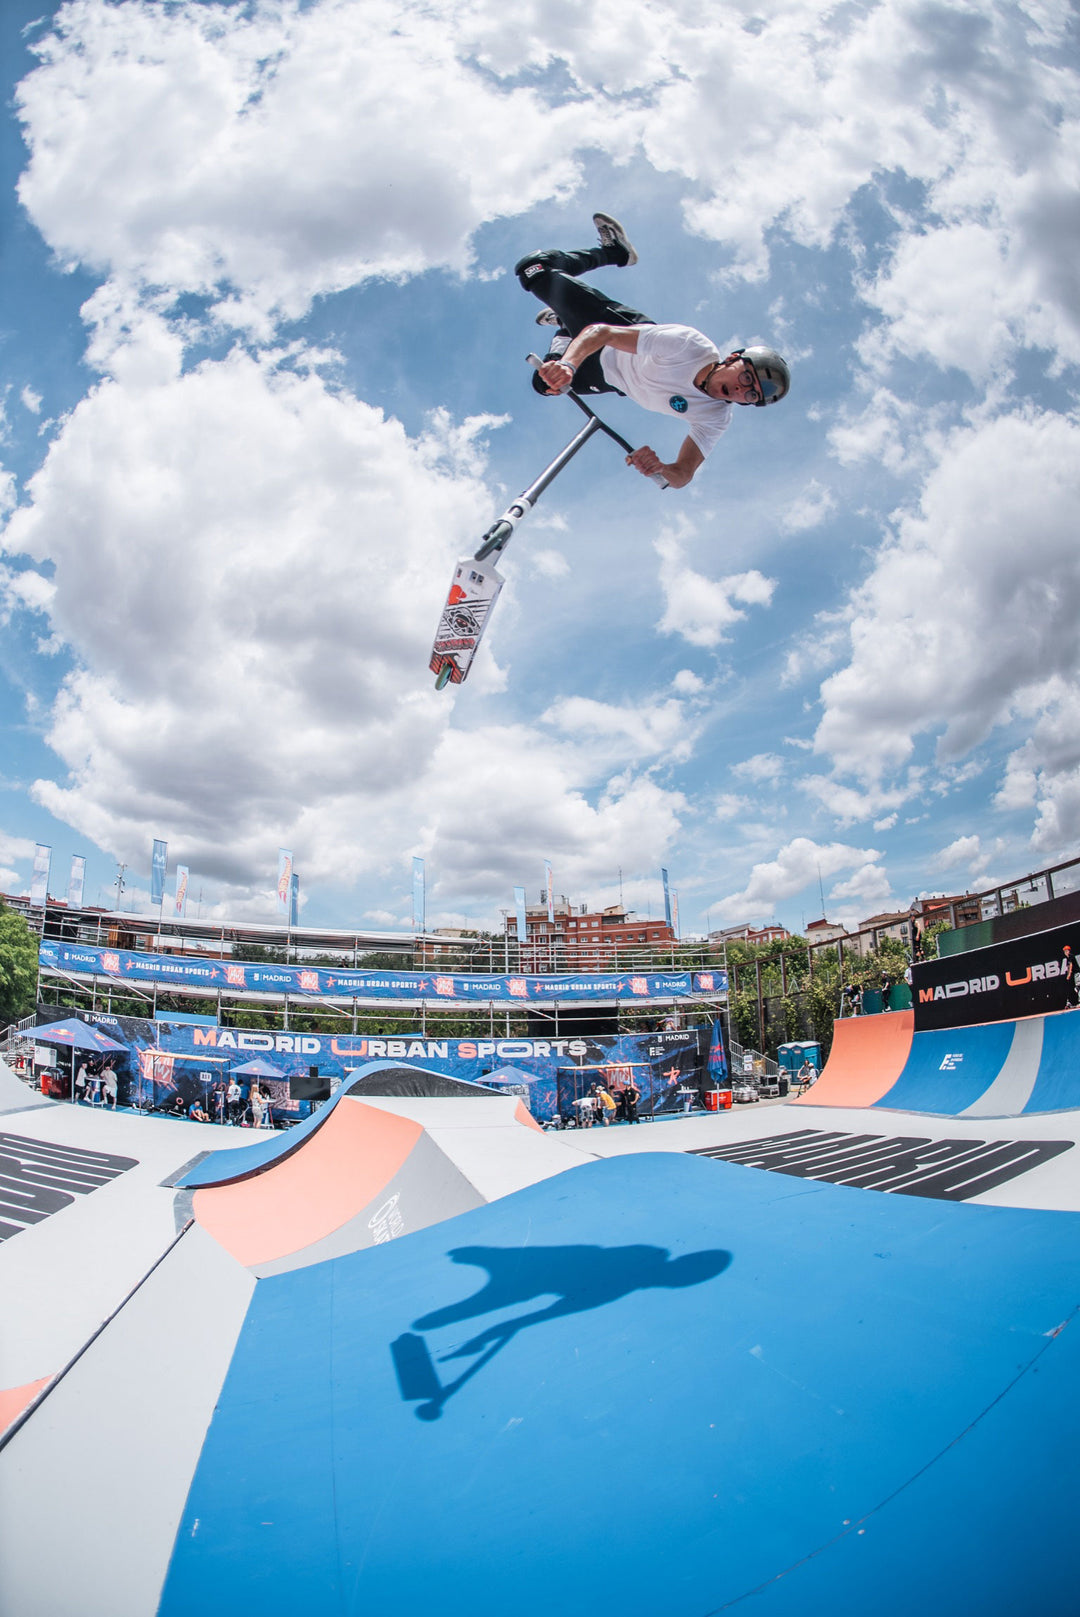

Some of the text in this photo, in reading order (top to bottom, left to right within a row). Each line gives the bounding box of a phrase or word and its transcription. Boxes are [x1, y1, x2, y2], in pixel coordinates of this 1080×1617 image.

[71, 954, 97, 963] MADRID
[136, 962, 210, 976] MADRID URBAN SPORTS
[263, 974, 292, 983] MADRID
[338, 979, 418, 989] MADRID URBAN SPORTS
[472, 983, 501, 991] MADRID
[570, 983, 592, 991] URBAN
[918, 974, 1000, 1003] MADRID
[92, 1016, 118, 1025] MADRID
[665, 1033, 690, 1041] MADRID
[193, 1028, 588, 1059] MADRID URBAN SPORTS
